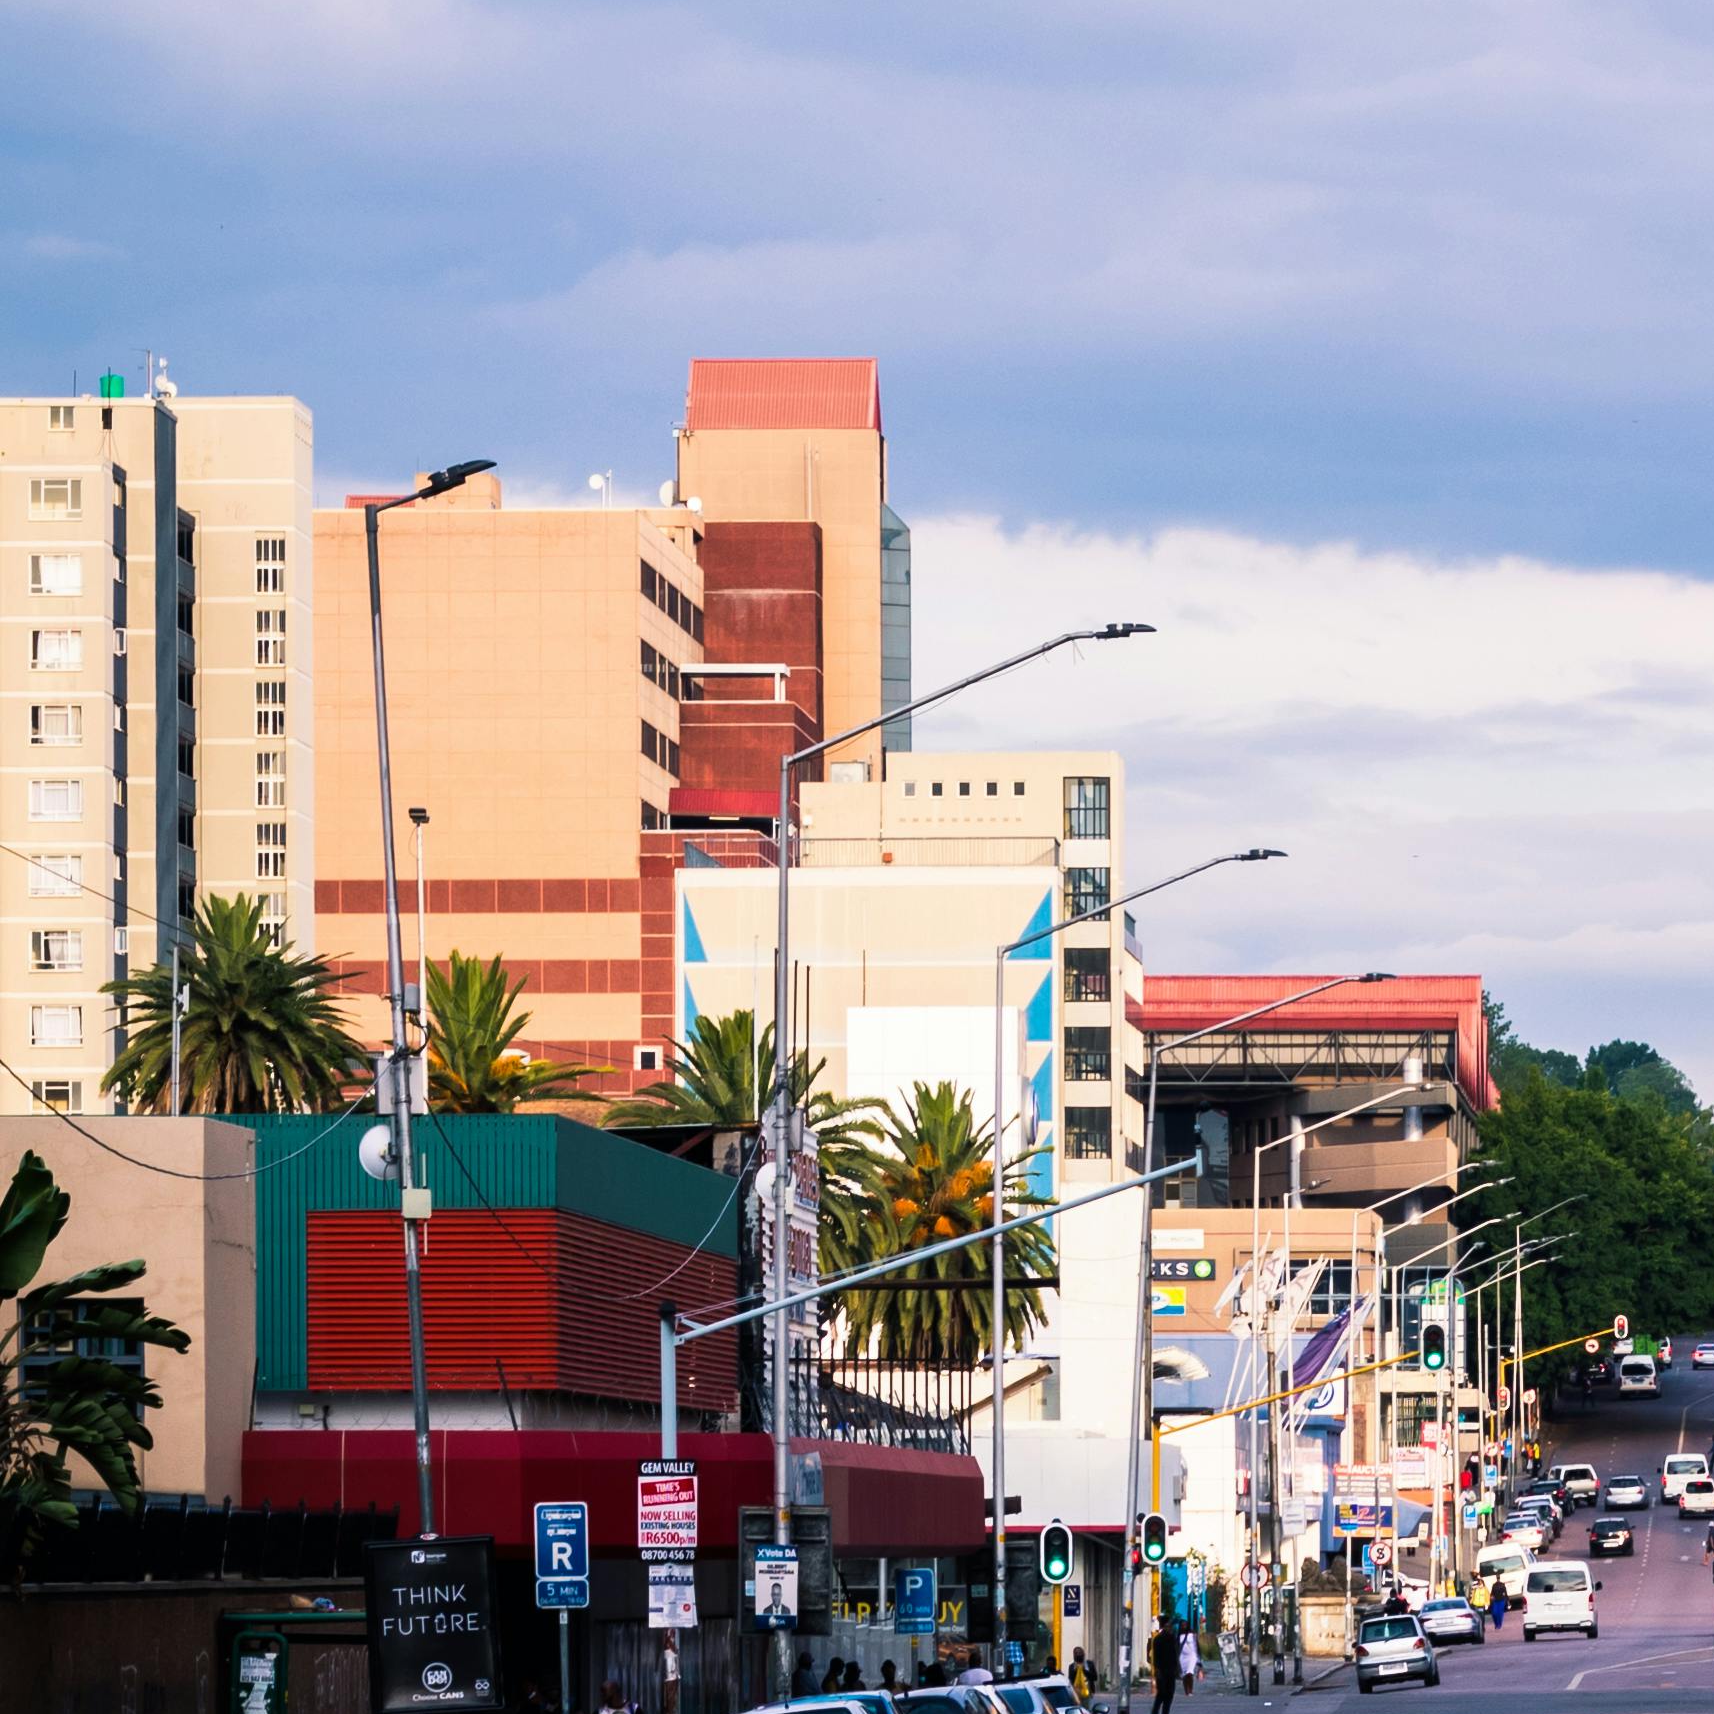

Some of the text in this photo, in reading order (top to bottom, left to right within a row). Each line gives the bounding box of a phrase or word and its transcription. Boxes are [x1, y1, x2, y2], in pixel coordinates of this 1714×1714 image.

[641, 1462, 694, 1474] GEM VALLEY
[679, 1490, 694, 1501] OUT
[641, 1511, 695, 1521] NOW SELLING
[552, 1541, 573, 1571] R
[641, 1549, 667, 1561] 08700
[669, 1549, 684, 1561] 456
[765, 1548, 783, 1558] Vote
[547, 1583, 578, 1596] 5 MIN
[905, 1576, 923, 1597] P
[392, 1584, 466, 1606] THINK
[412, 1691, 464, 1702] Choose CANS
